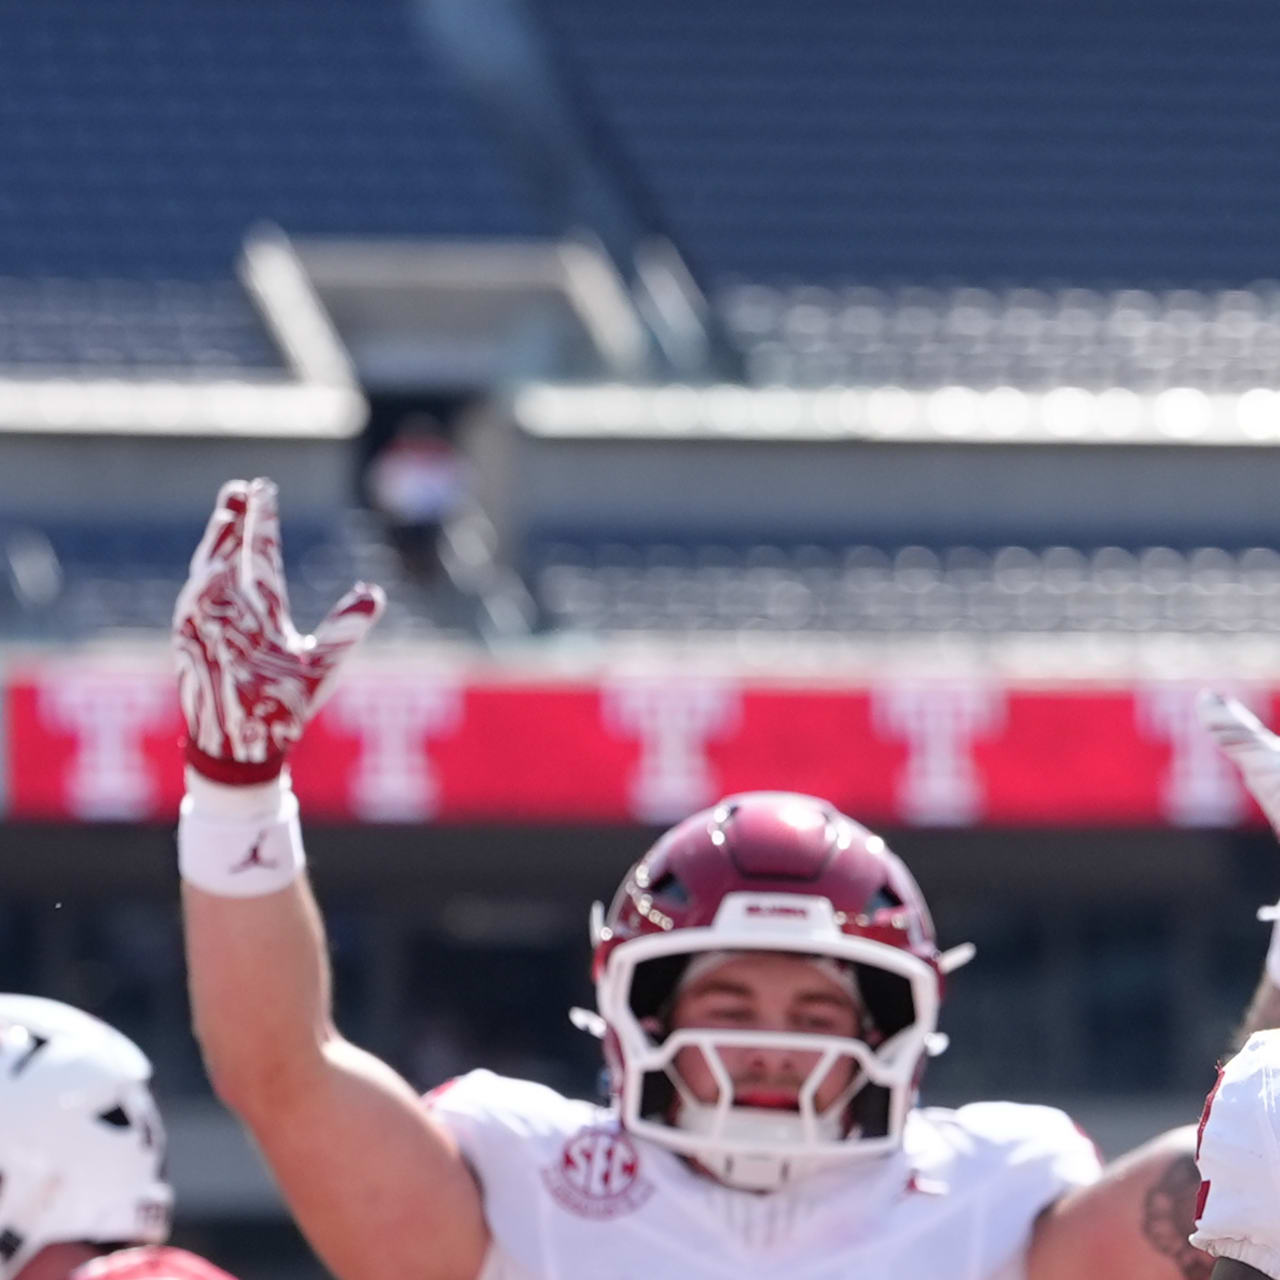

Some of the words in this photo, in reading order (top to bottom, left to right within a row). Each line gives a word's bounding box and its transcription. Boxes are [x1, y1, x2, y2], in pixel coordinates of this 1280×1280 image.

[333, 672, 464, 824] T
[609, 674, 741, 825] T
[871, 676, 1008, 828] T
[567, 1135, 633, 1196] SEC
